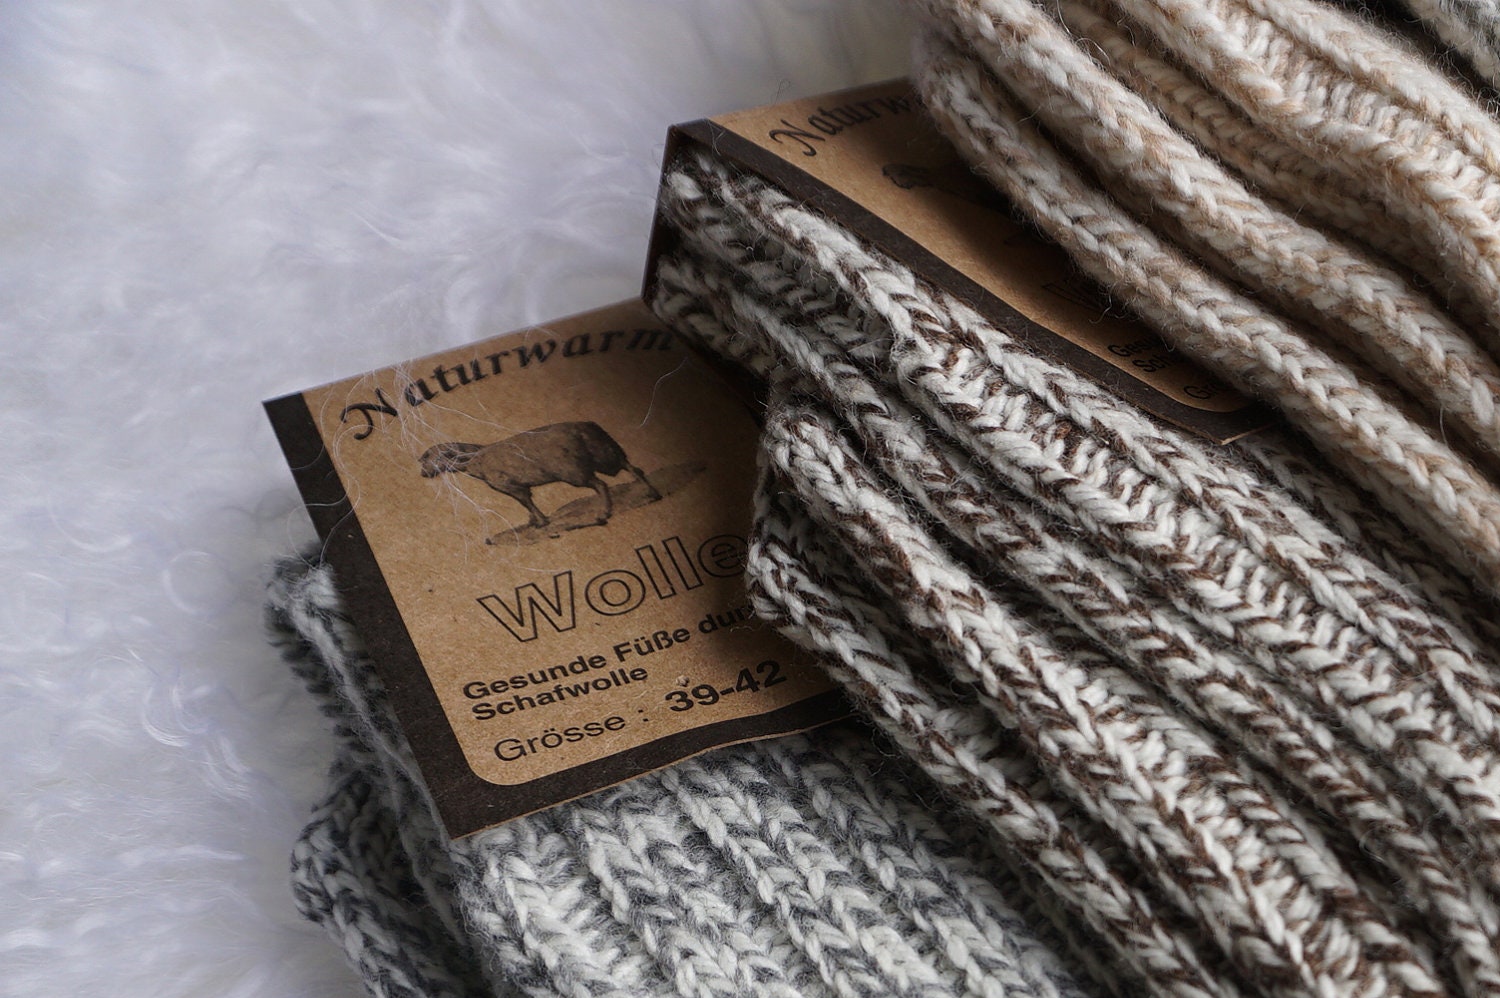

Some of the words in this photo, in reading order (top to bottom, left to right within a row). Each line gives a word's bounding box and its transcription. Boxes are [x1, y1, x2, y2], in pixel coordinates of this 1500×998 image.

[340, 327, 673, 440] Naturwarm
[476, 533, 750, 643] Wolle
[462, 653, 608, 700] Gesunde
[613, 629, 691, 663] Füße
[471, 666, 649, 721] Schafwolle
[493, 713, 627, 762] Grösse
[664, 660, 788, 712] 39-42
